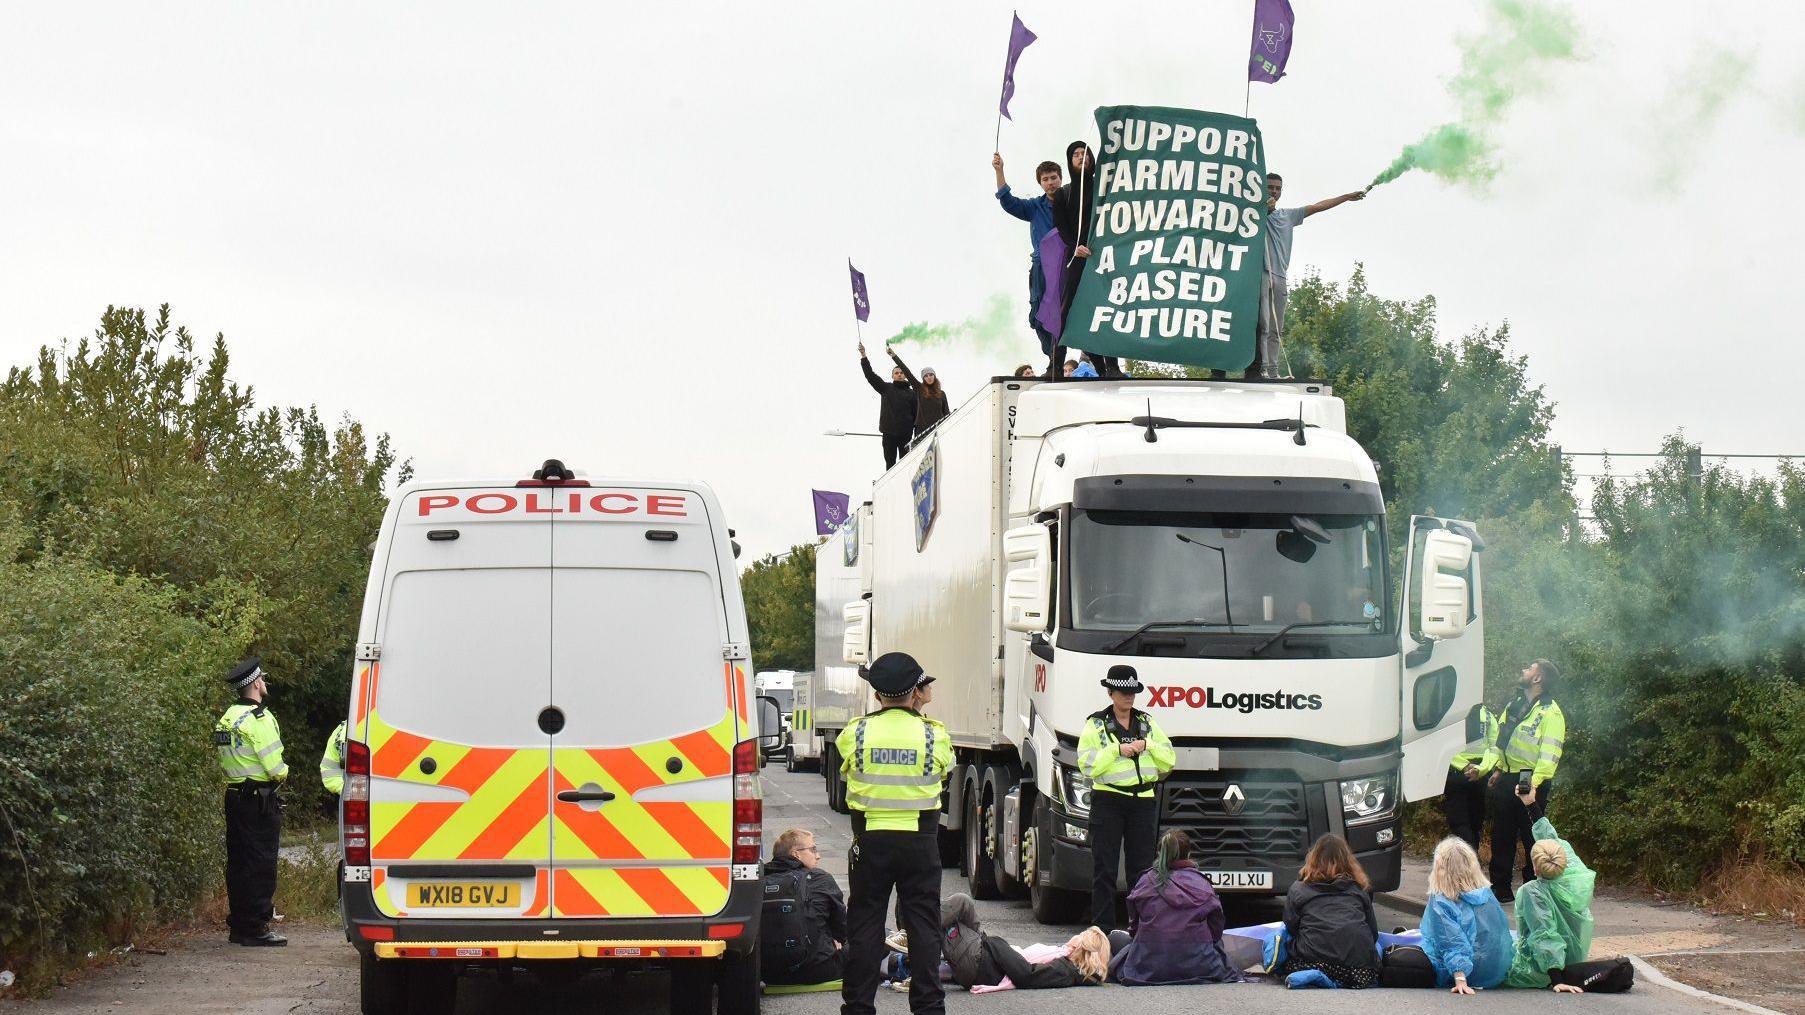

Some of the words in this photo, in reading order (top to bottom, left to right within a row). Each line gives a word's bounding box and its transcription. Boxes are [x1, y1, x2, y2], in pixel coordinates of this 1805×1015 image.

[1104, 118, 1258, 165] SUPPORT
[1098, 159, 1263, 203] FARMERS
[1095, 198, 1261, 238] TOWARDS
[1095, 245, 1116, 275] A
[1129, 235, 1249, 271] PLANT
[1107, 269, 1227, 306] BASED
[1089, 306, 1233, 342] FUTURE
[418, 493, 688, 517] POLICE
[872, 748, 916, 765] POLICE
[419, 885, 463, 904] WX18
[469, 885, 508, 904] GVJ
[1238, 873, 1265, 886] LXU
